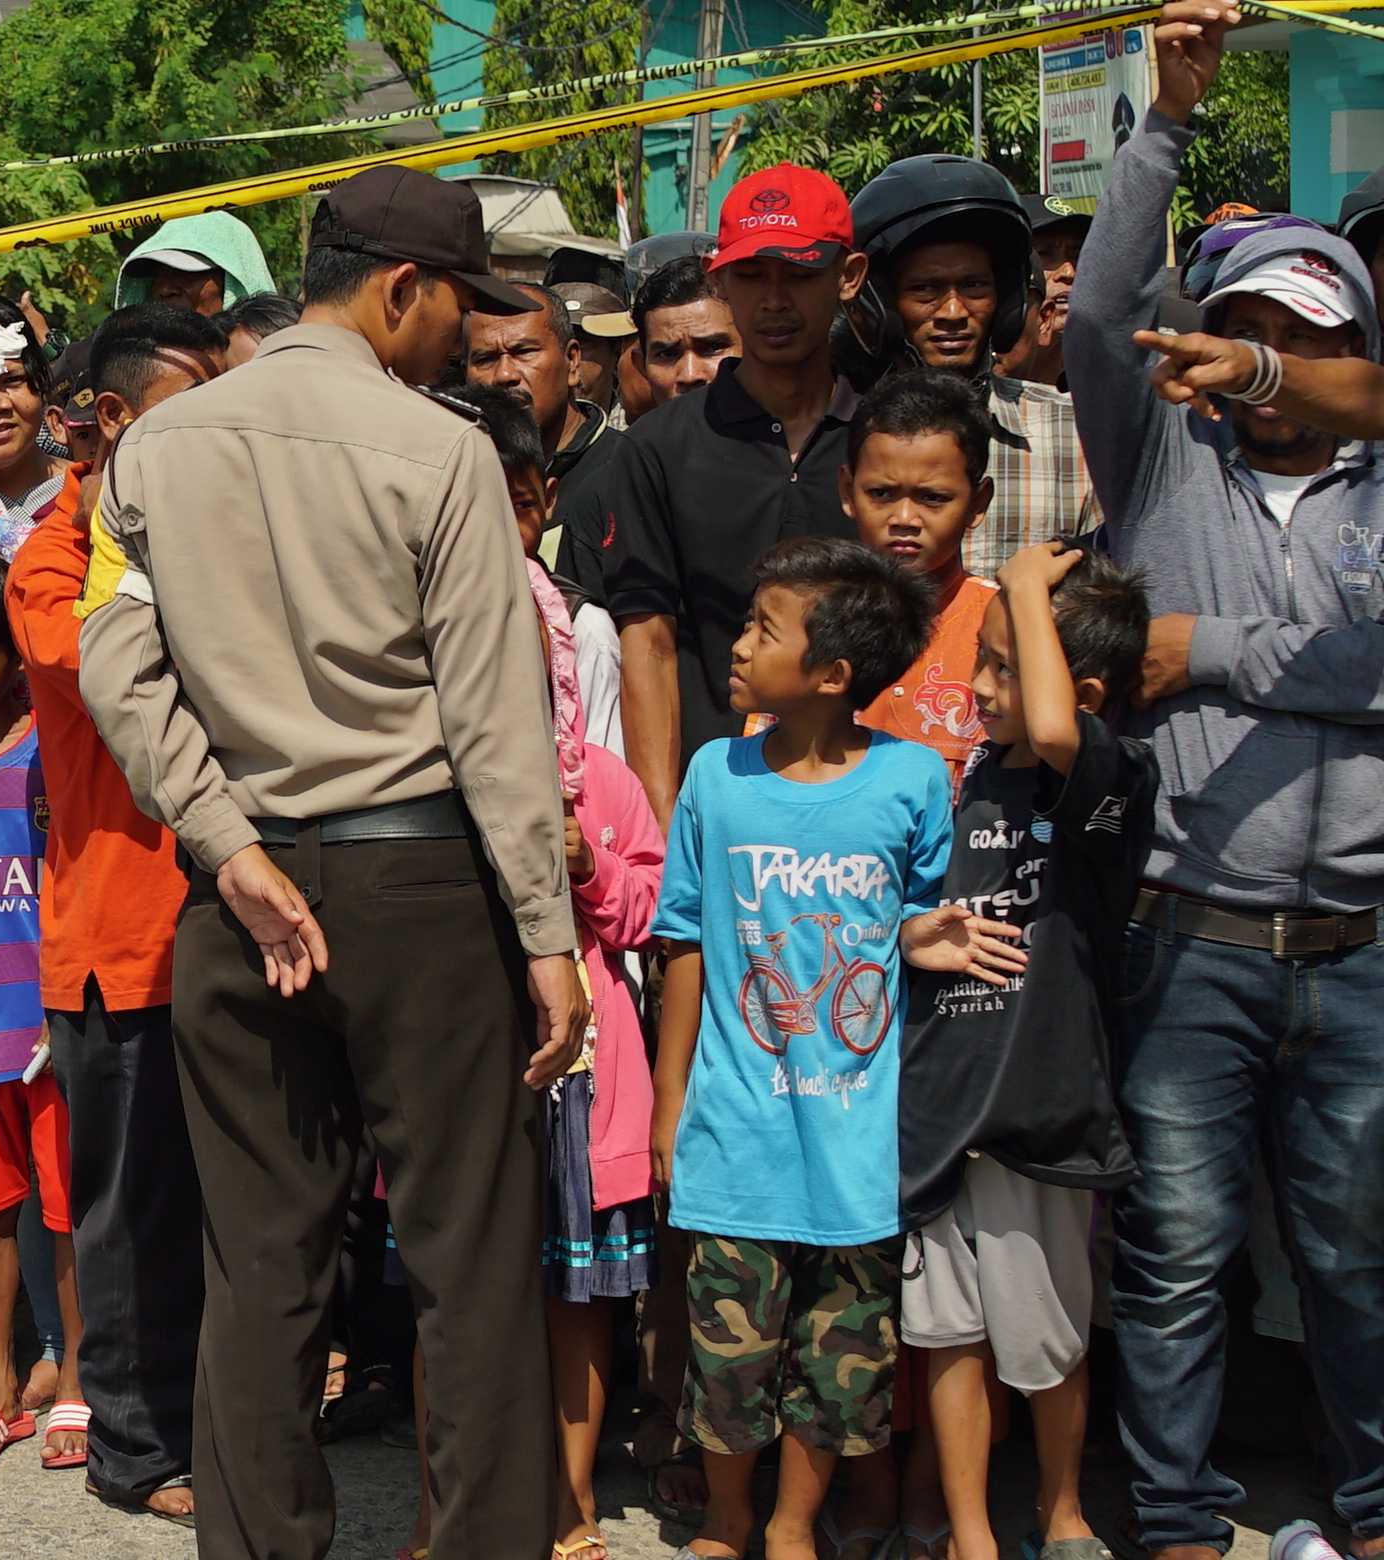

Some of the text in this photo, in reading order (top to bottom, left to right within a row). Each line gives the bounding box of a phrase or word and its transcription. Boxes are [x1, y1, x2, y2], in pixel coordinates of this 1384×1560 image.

[739, 214, 798, 229] TOYOTA
[728, 845, 890, 912] JAKARTA
[937, 996, 1005, 1018] Syariah
